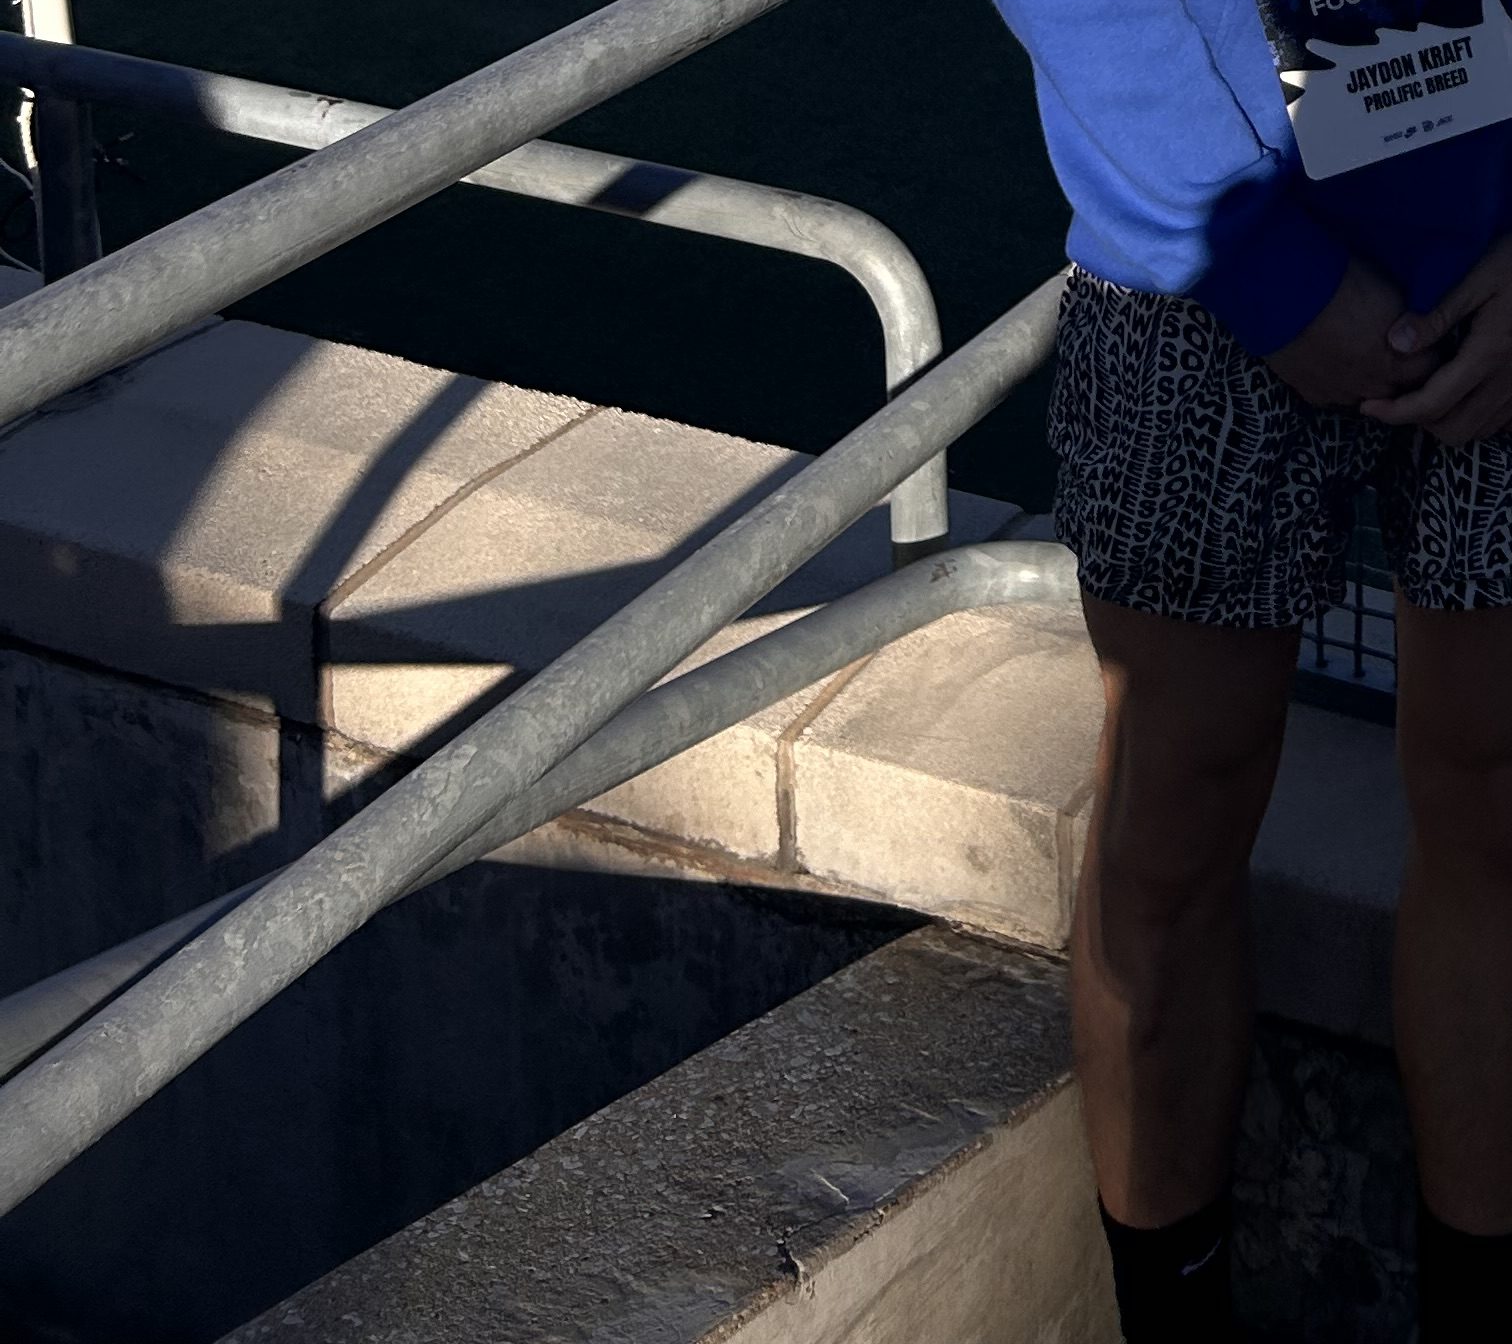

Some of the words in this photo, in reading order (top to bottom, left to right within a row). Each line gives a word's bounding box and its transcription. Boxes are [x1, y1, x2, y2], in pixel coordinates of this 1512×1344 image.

[1346, 53, 1417, 94] JAYDON
[1418, 36, 1473, 72] KRAFT
[1363, 81, 1424, 114] PROLIFIC
[1424, 67, 1469, 95] BREED
